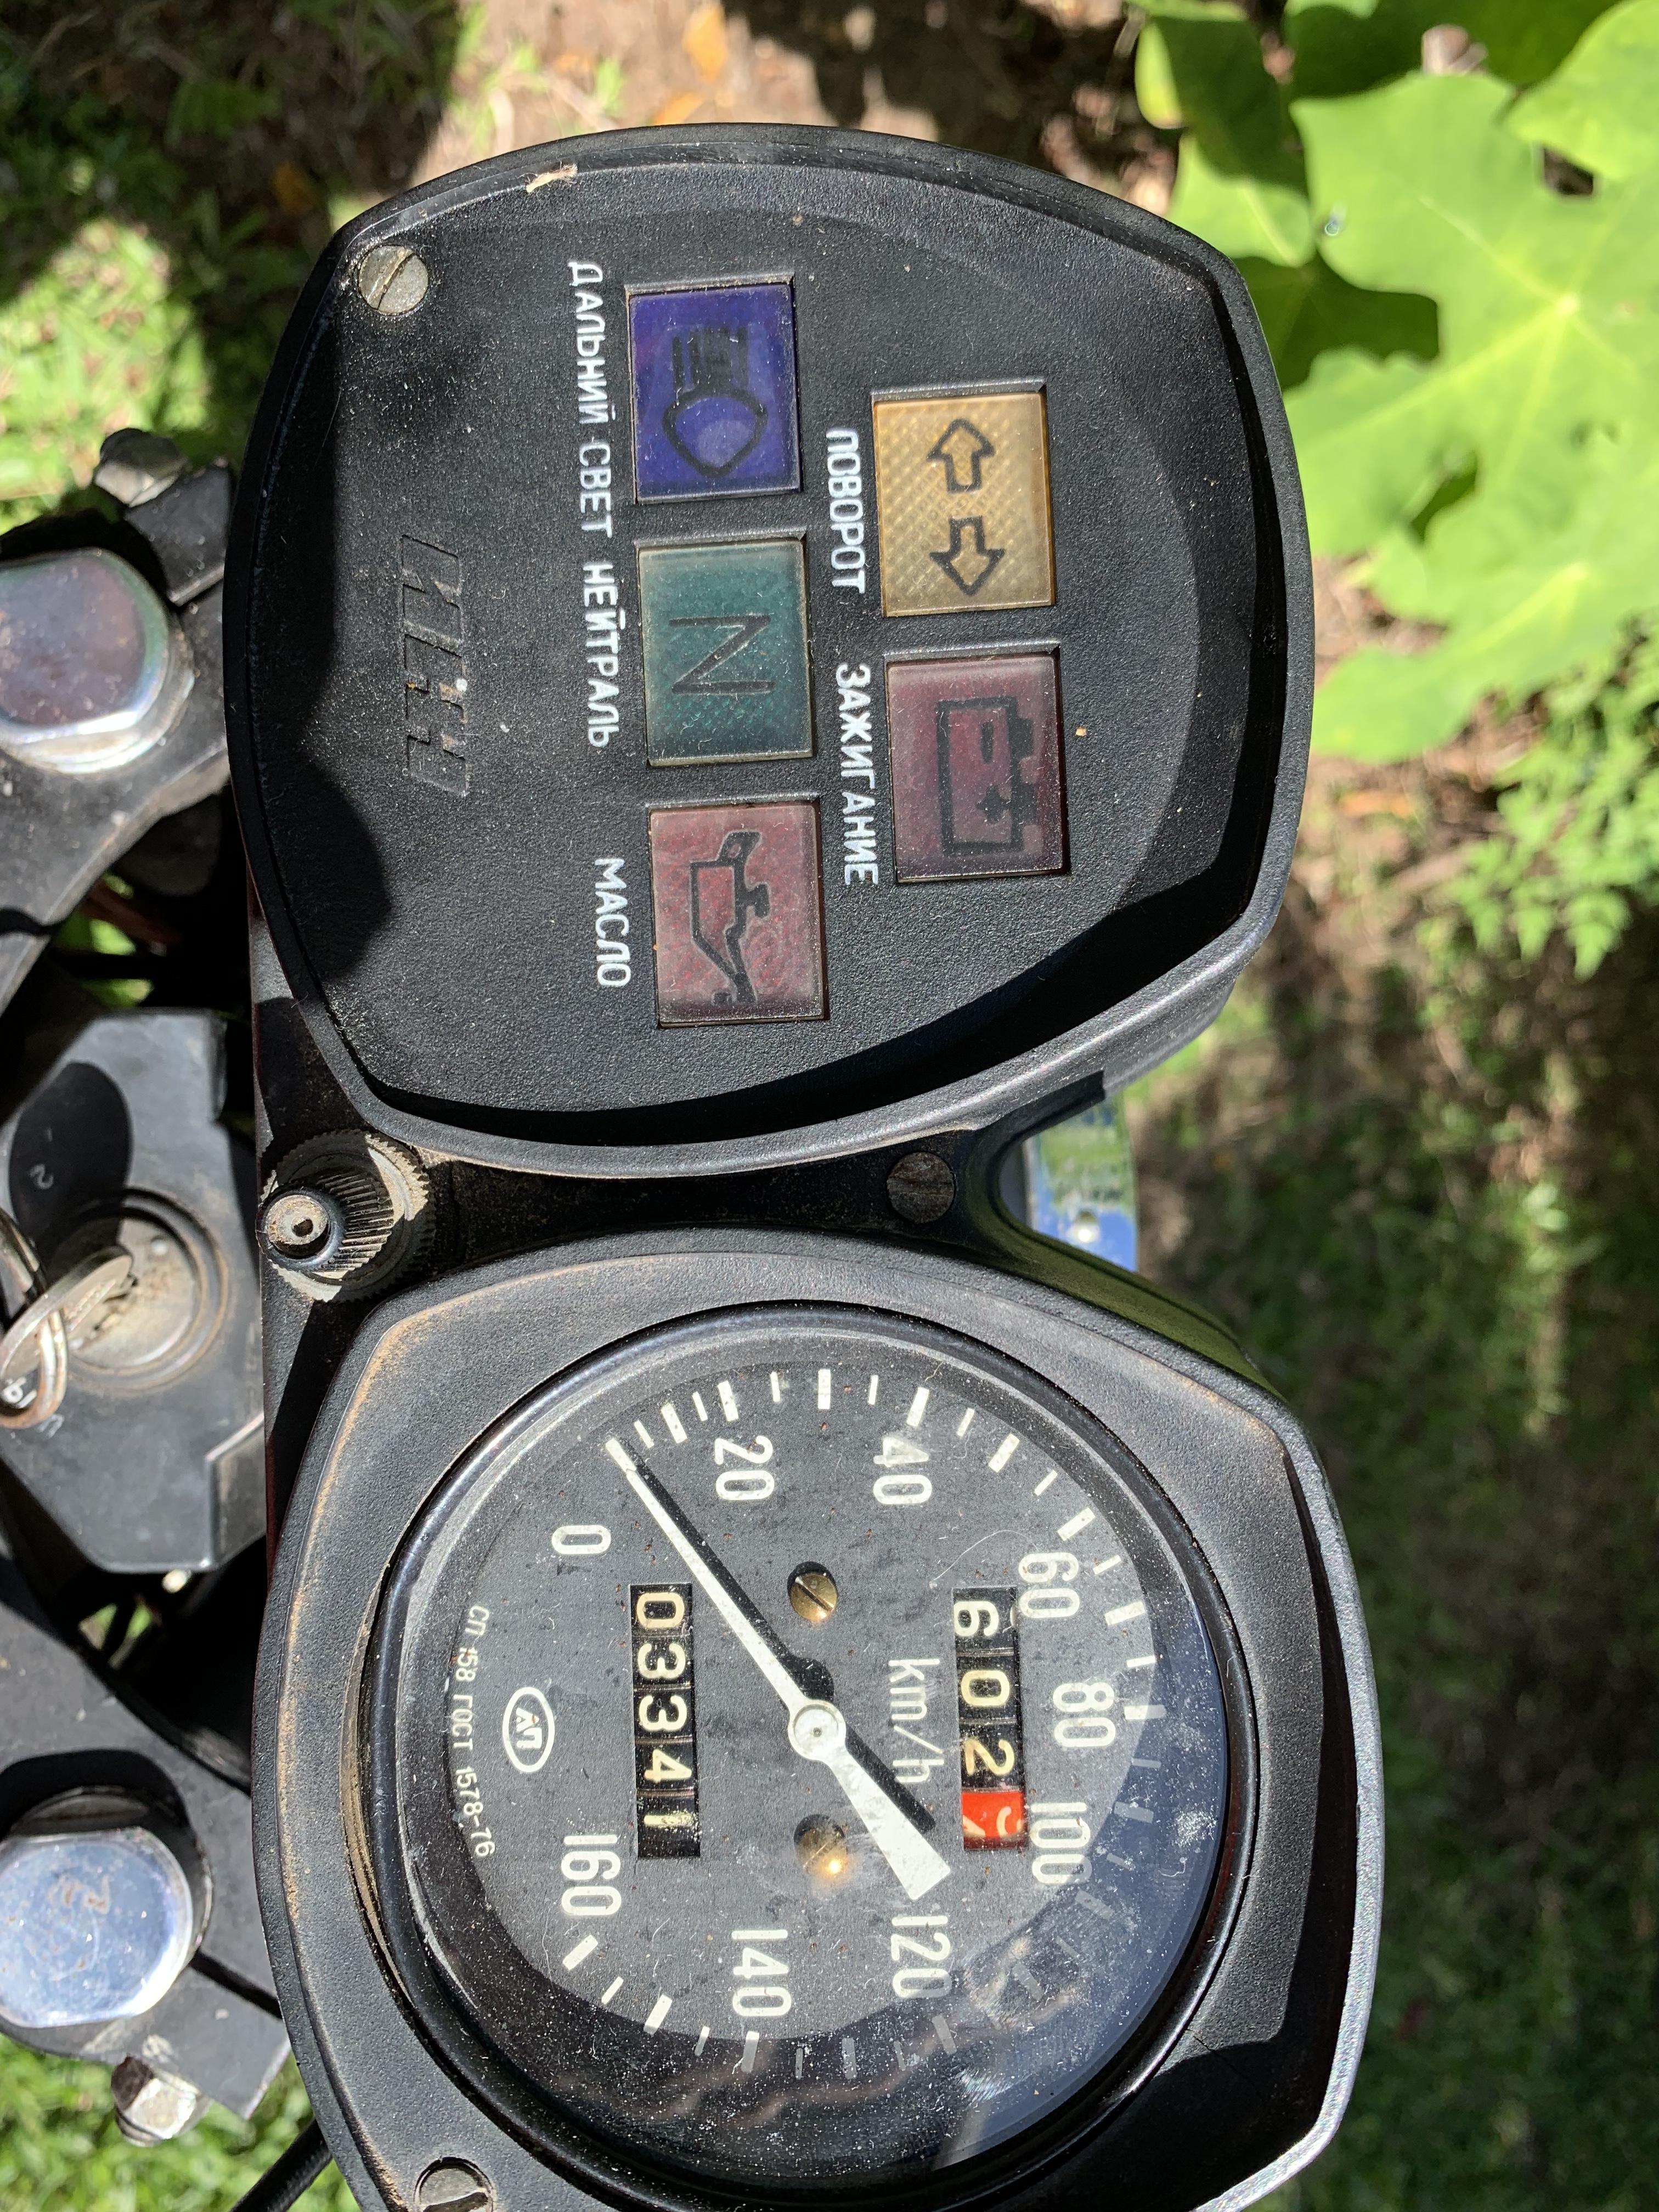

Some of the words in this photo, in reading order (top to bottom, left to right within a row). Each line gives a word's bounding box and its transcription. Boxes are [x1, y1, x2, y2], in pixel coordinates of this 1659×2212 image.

[567, 259, 616, 425] ДАЛЬНИЙ
[578, 441, 614, 538] СВЕТ
[826, 428, 867, 594] ПОВОРОТ
[580, 560, 628, 748] НЕЙТРАЛЬ
[834, 662, 879, 886] ЗАЖИГАНИЕ
[593, 857, 632, 989] МАСЛО
[713, 1435, 775, 1502] 20
[871, 1437, 933, 1505] 40
[551, 1524, 610, 1555] 0
[465, 1605, 490, 1637] СП
[1017, 1551, 1080, 1619] 60
[452, 1694, 472, 1750] ГОСТ
[635, 1591, 690, 1827] 03341
[886, 1657, 945, 1784] km/h
[1052, 1681, 1116, 1750] 80
[455, 1765, 495, 1858] 1578-76
[1030, 1801, 1093, 1886] 100
[560, 1835, 621, 1919] 160
[730, 1929, 792, 2017] 140
[890, 1914, 953, 2000] 120
